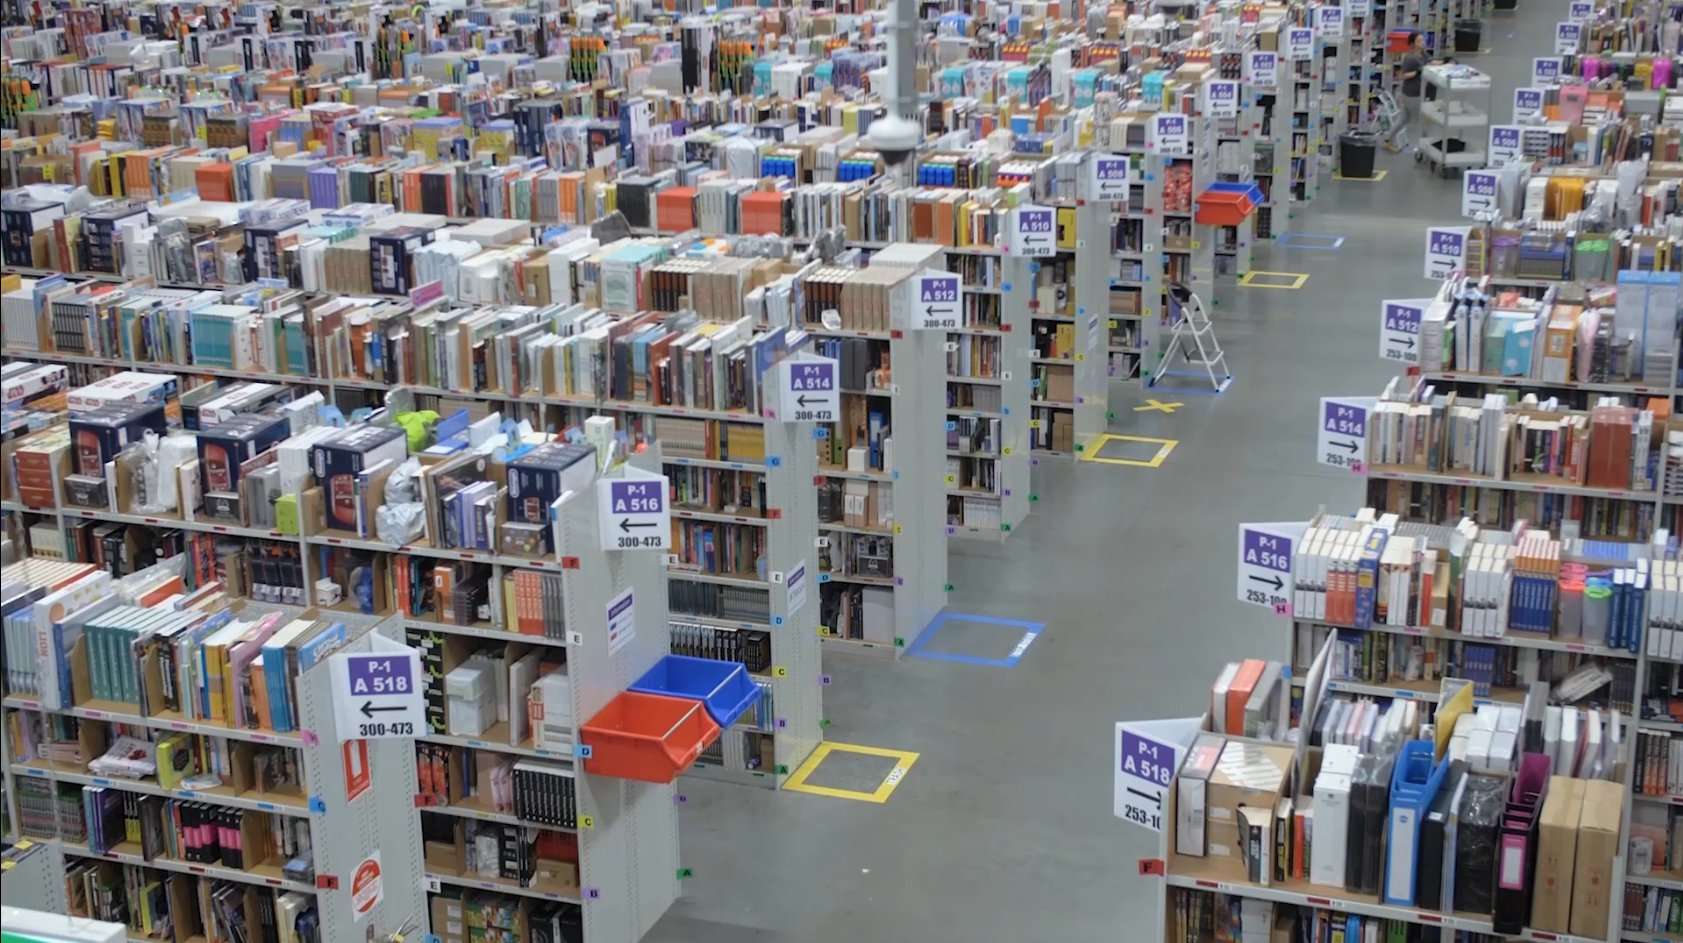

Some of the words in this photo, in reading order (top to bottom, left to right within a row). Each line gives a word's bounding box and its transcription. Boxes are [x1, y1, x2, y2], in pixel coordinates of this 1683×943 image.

[1029, 212, 1042, 220] P-1
[1021, 222, 1030, 231] A
[1031, 222, 1050, 231] 510
[1440, 234, 1453, 243] P-1
[1432, 243, 1441, 252] A
[1442, 245, 1460, 255] 510
[932, 281, 947, 289] P-1
[923, 291, 932, 300] A
[935, 291, 955, 300] 512
[1397, 309, 1411, 319] P-1
[924, 320, 955, 328] 300-473
[1387, 318, 1397, 329] A
[1398, 320, 1418, 332] 512
[804, 366, 820, 376] P-1
[793, 379, 804, 389] A
[807, 378, 831, 389] 514
[795, 411, 832, 421] 300-473
[1338, 407, 1353, 419] P-1
[1327, 418, 1337, 430] A
[1340, 420, 1362, 434] 514
[1352, 463, 1362, 473] H
[628, 484, 647, 496] P-1
[615, 499, 627, 512] A
[632, 497, 659, 511] 516
[618, 537, 662, 548] 300-473
[1259, 536, 1277, 550] P-1
[669, 555, 677, 564] E
[1246, 549, 1258, 563] A
[1261, 551, 1288, 570] 516
[823, 574, 829, 582] D
[1276, 605, 1287, 615] H
[776, 616, 782, 625] D
[574, 634, 580, 643] E
[369, 660, 391, 673] P-1
[778, 668, 785, 676] C
[354, 679, 369, 693] A
[374, 676, 408, 692] 518
[780, 719, 786, 727] B
[360, 722, 413, 737] 300-473
[582, 747, 590, 756] D
[1138, 741, 1158, 760] P-1
[1124, 754, 1137, 774] A
[1141, 759, 1170, 786] 518
[585, 818, 592, 826] C
[431, 880, 440, 890] E
[590, 889, 598, 898] B
